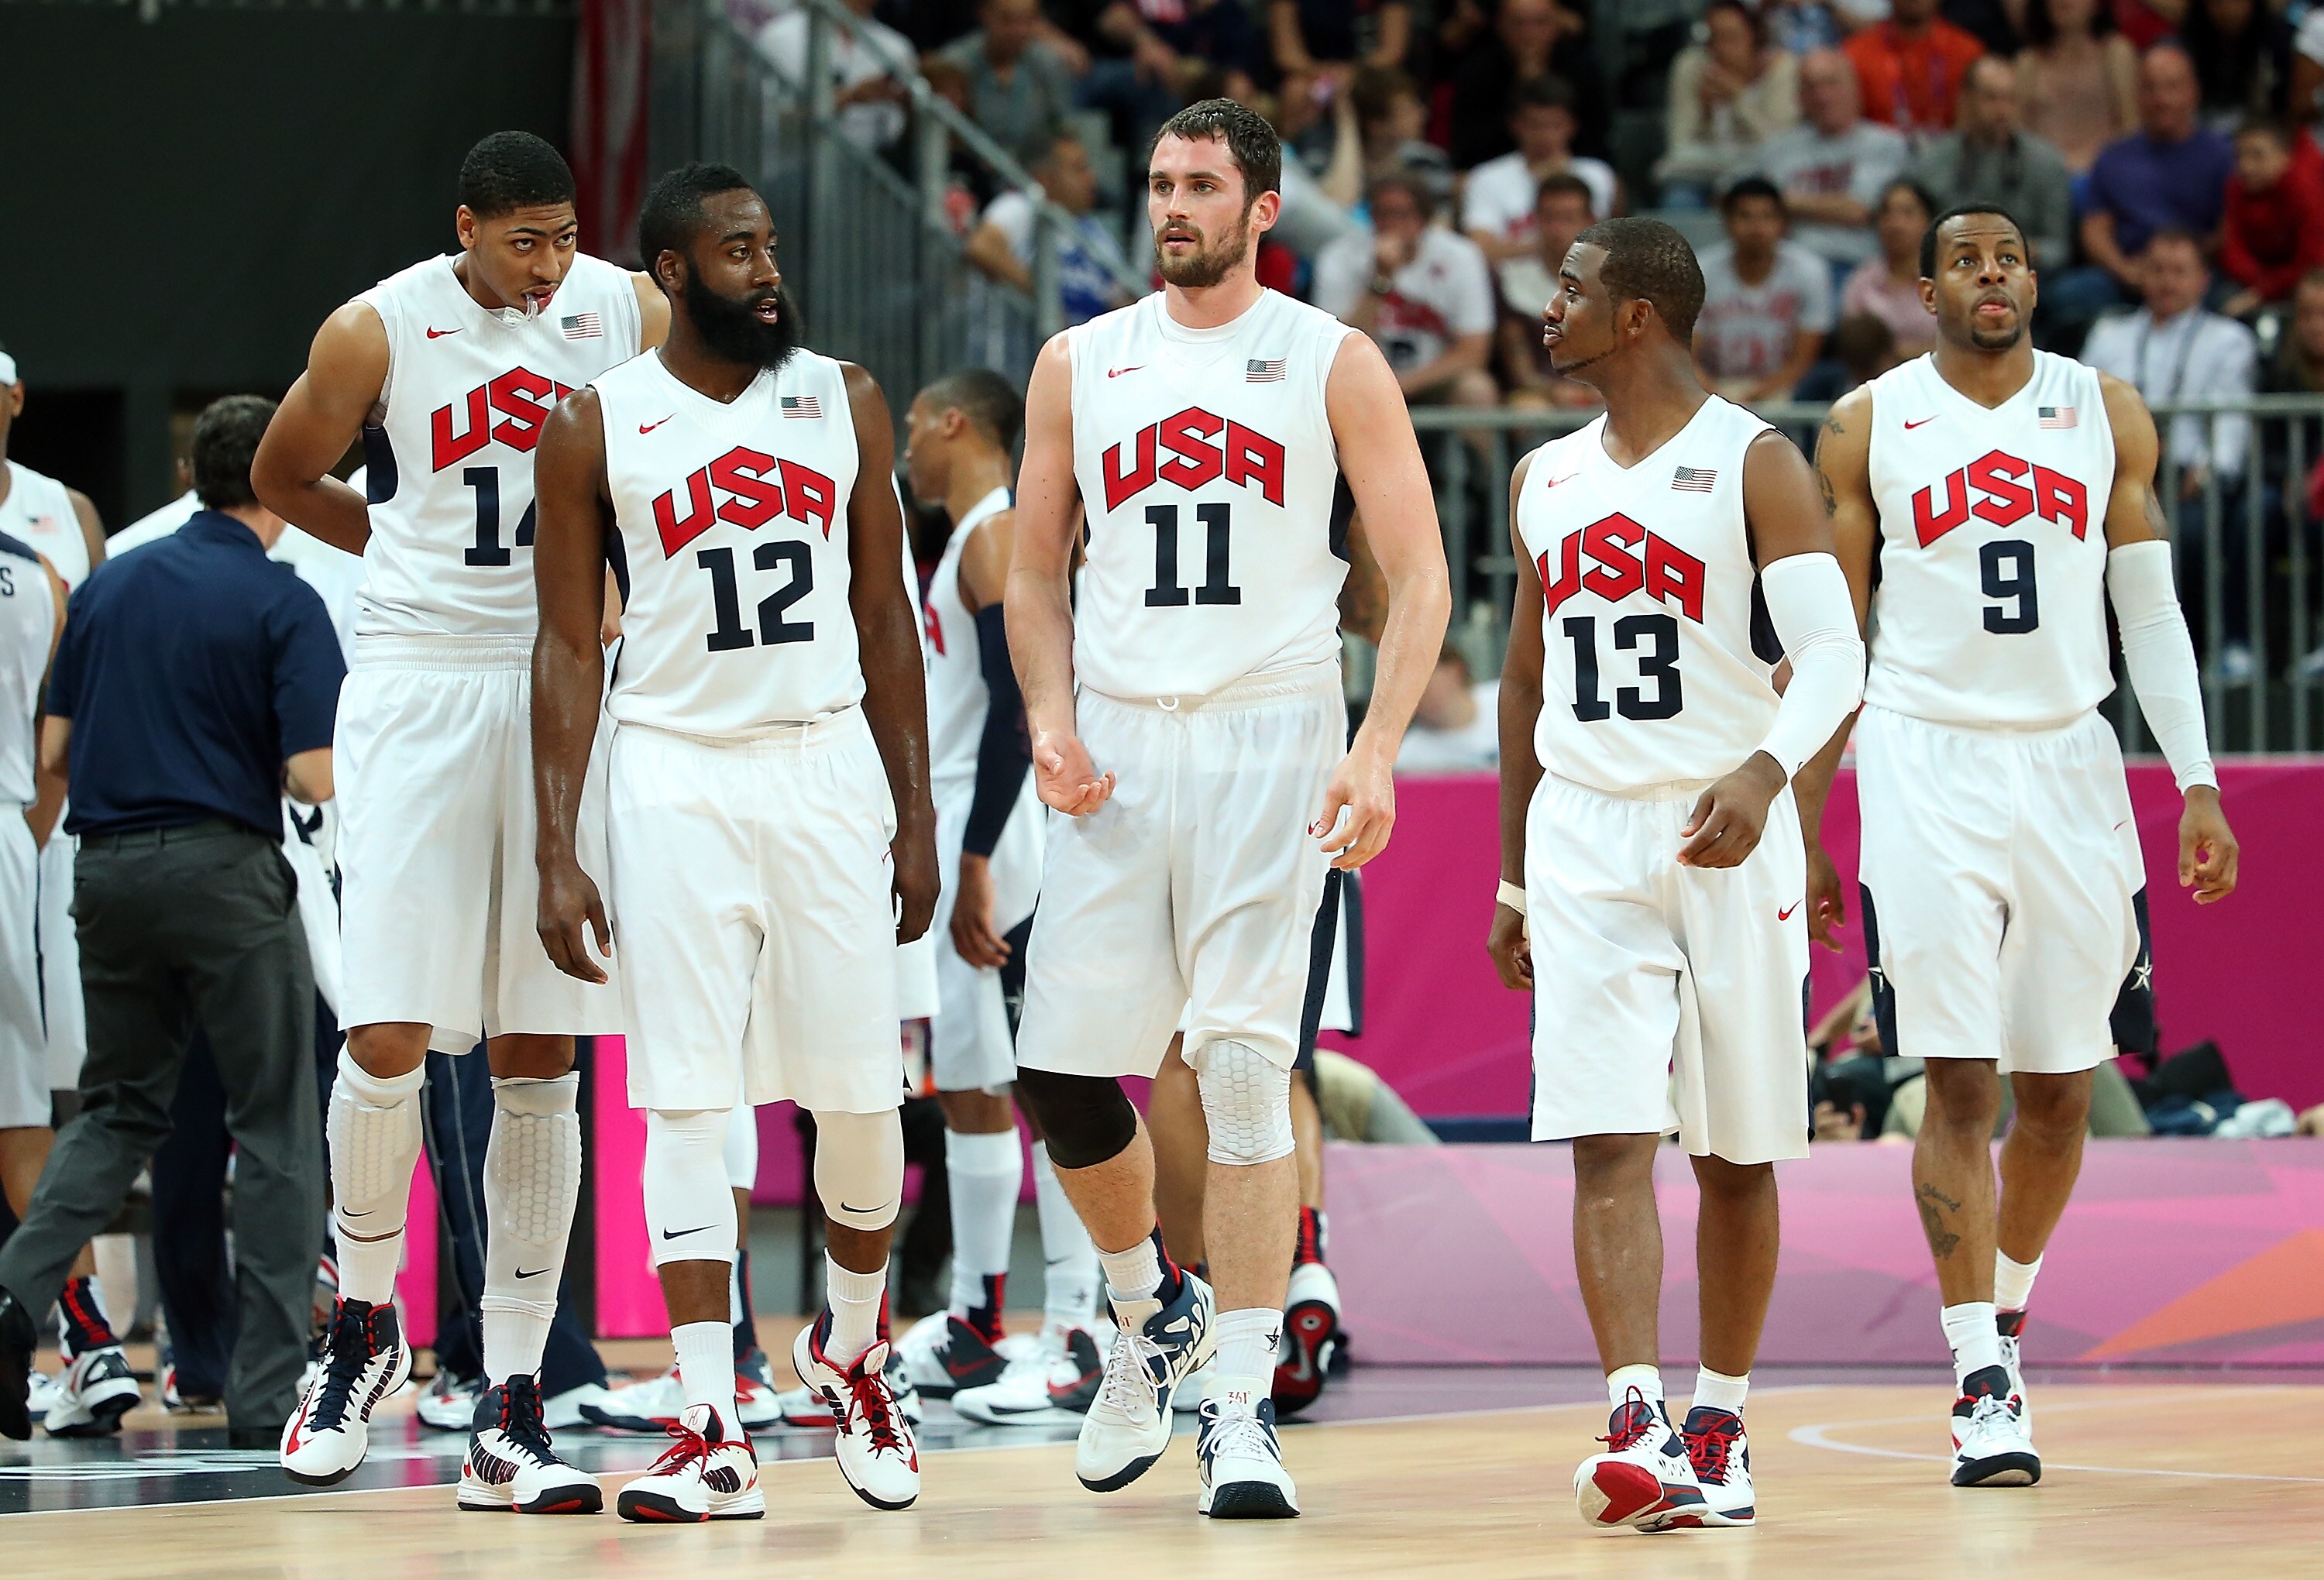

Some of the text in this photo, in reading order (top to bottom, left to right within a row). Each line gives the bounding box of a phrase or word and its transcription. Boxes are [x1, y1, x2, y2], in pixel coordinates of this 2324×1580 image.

[431, 366, 576, 473] US
[1102, 406, 1285, 514] USA
[651, 445, 836, 561] USA
[1912, 448, 2089, 549] USA
[696, 540, 814, 652] 12
[1145, 503, 1241, 607] 11
[1536, 511, 1707, 625] USA
[1978, 539, 2039, 634] 9
[1562, 613, 1683, 722] 13
